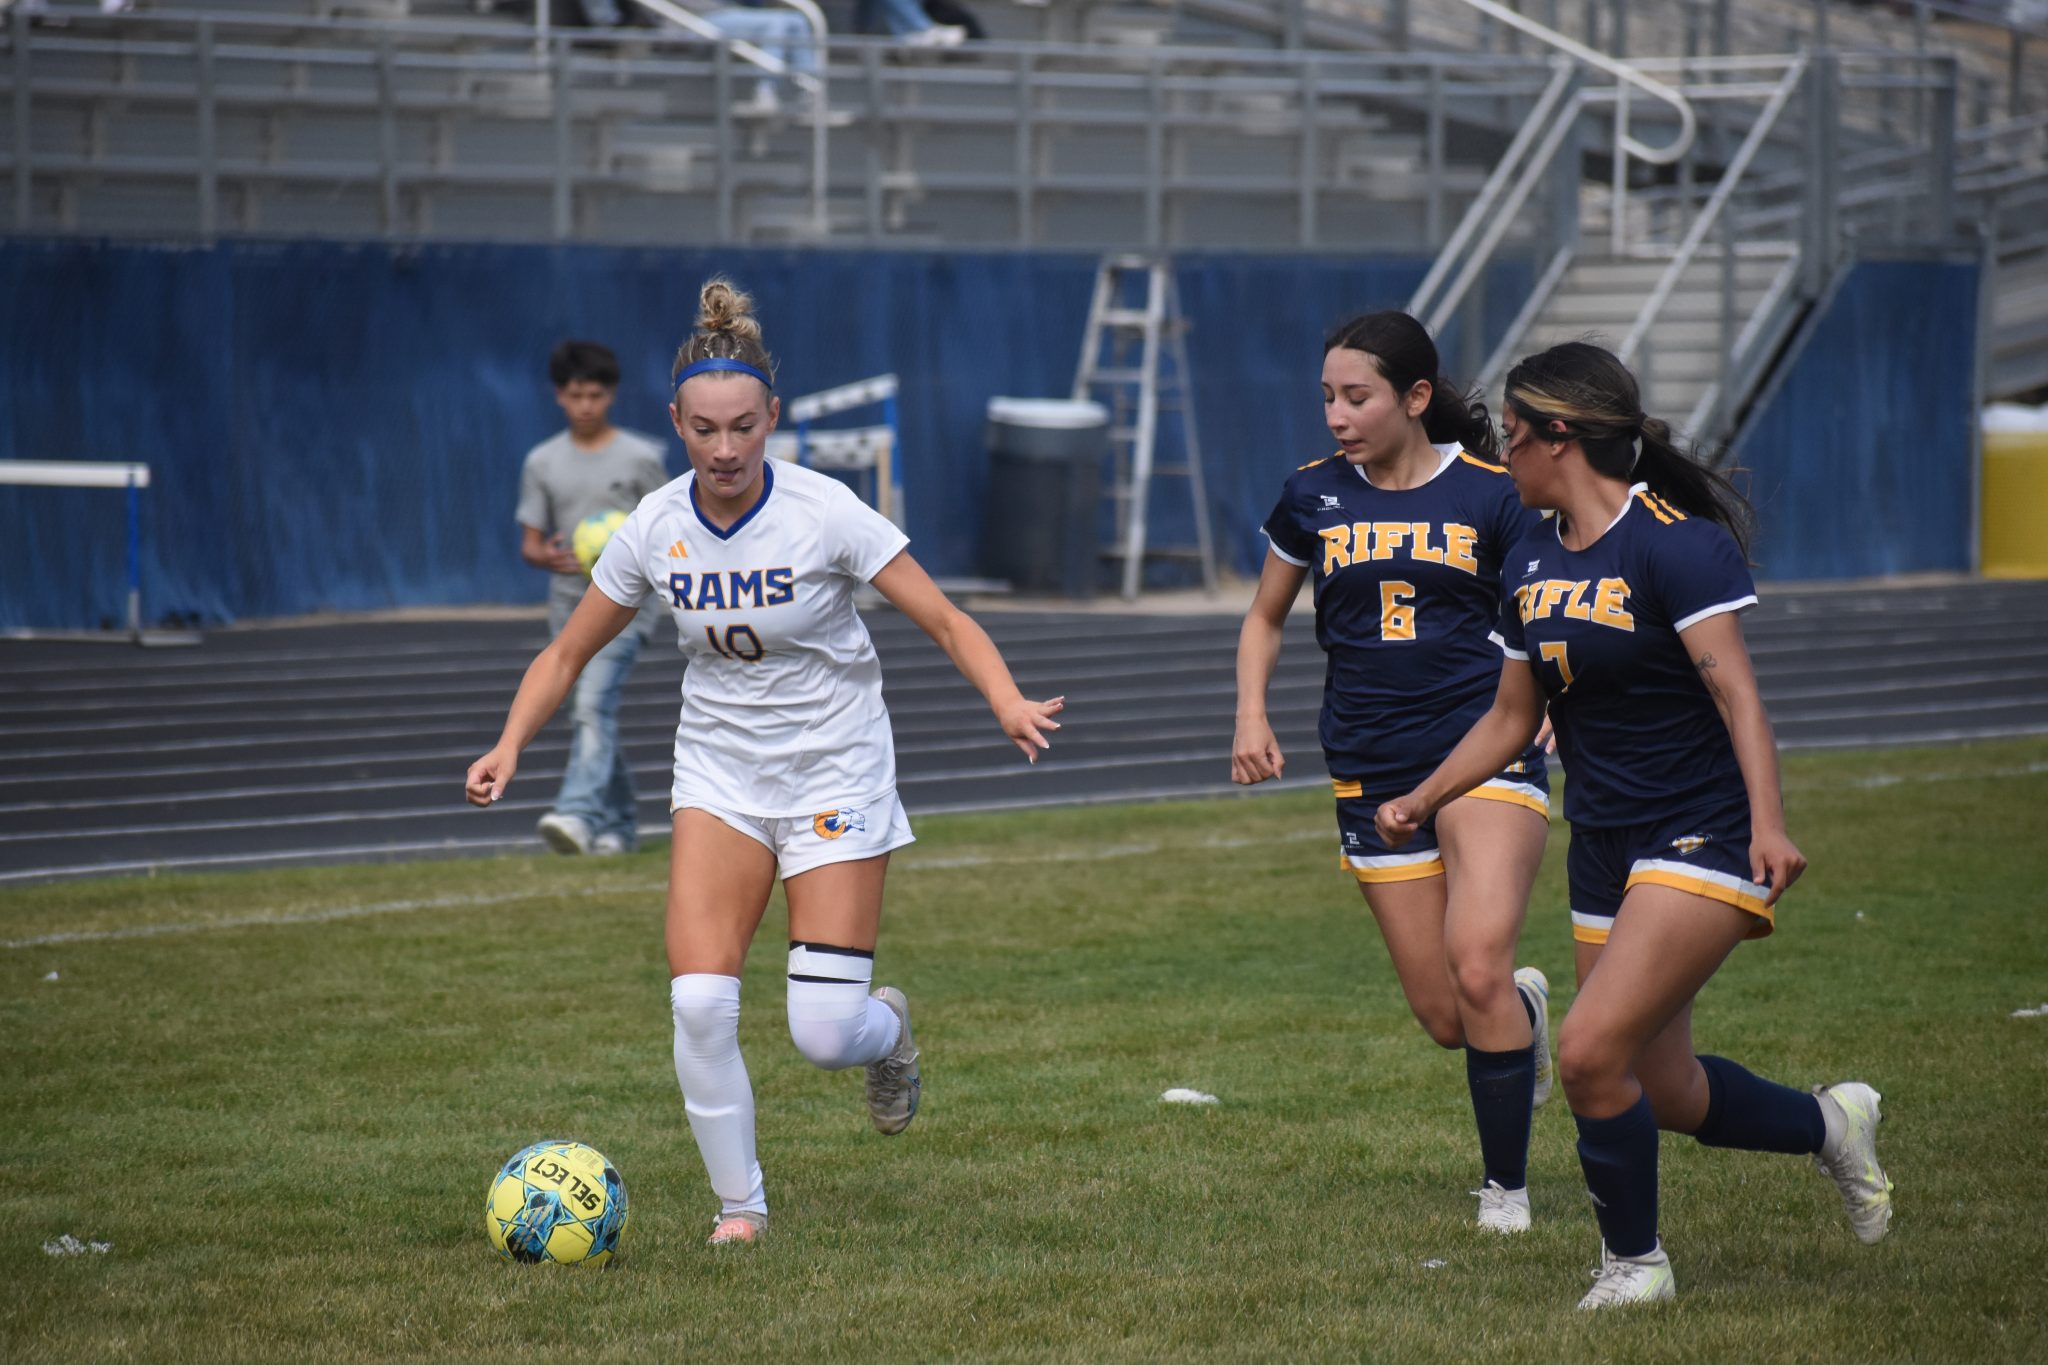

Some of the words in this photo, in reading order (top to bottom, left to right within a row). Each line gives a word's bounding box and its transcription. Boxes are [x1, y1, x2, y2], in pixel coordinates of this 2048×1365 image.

[1318, 522, 1478, 577] RIFLE
[669, 567, 795, 611] RAMS
[1379, 581, 1416, 641] 6
[704, 624, 765, 664] 10
[1539, 641, 1574, 693] 7
[531, 1158, 601, 1211] SELECT
